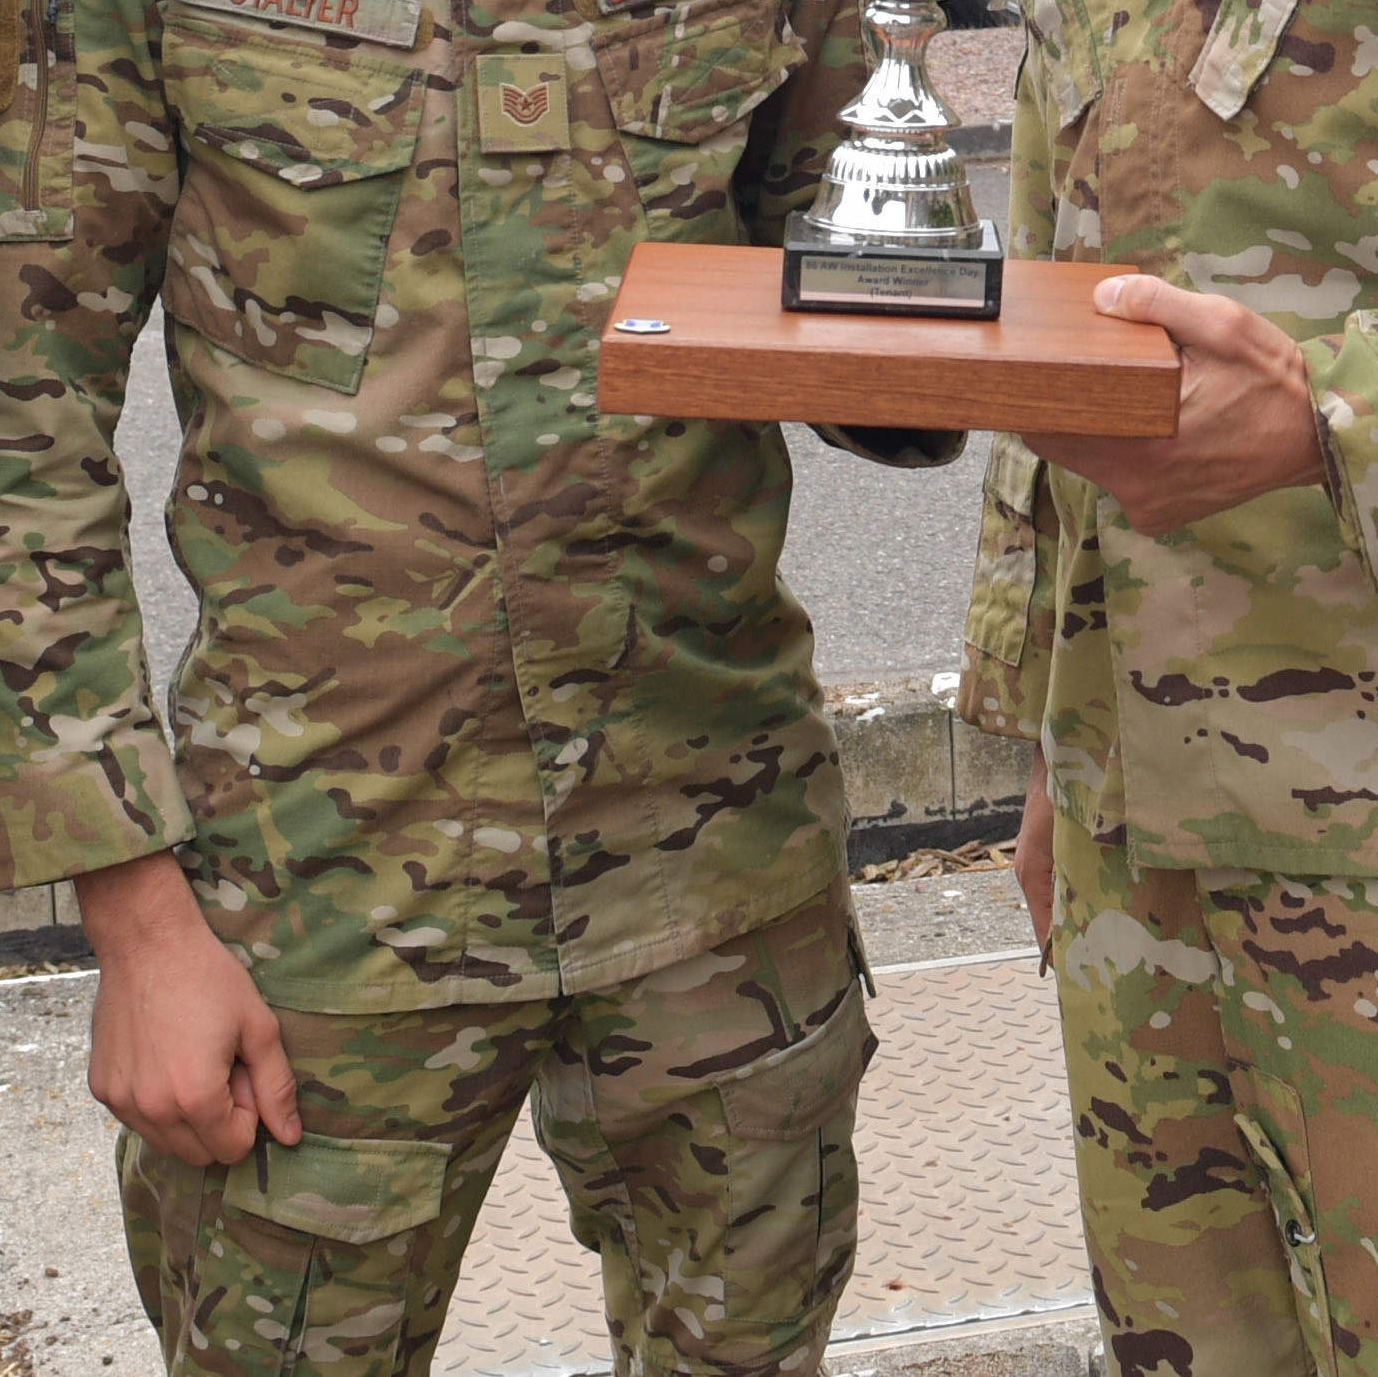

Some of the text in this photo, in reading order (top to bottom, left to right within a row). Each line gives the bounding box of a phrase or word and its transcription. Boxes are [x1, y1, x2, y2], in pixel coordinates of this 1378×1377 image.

[819, 261, 838, 271] AW
[840, 262, 898, 274] Installation
[900, 264, 956, 276] Excellence
[959, 266, 980, 279] Day
[856, 274, 930, 287] Award Winner
[869, 287, 913, 300] (Tenant)
